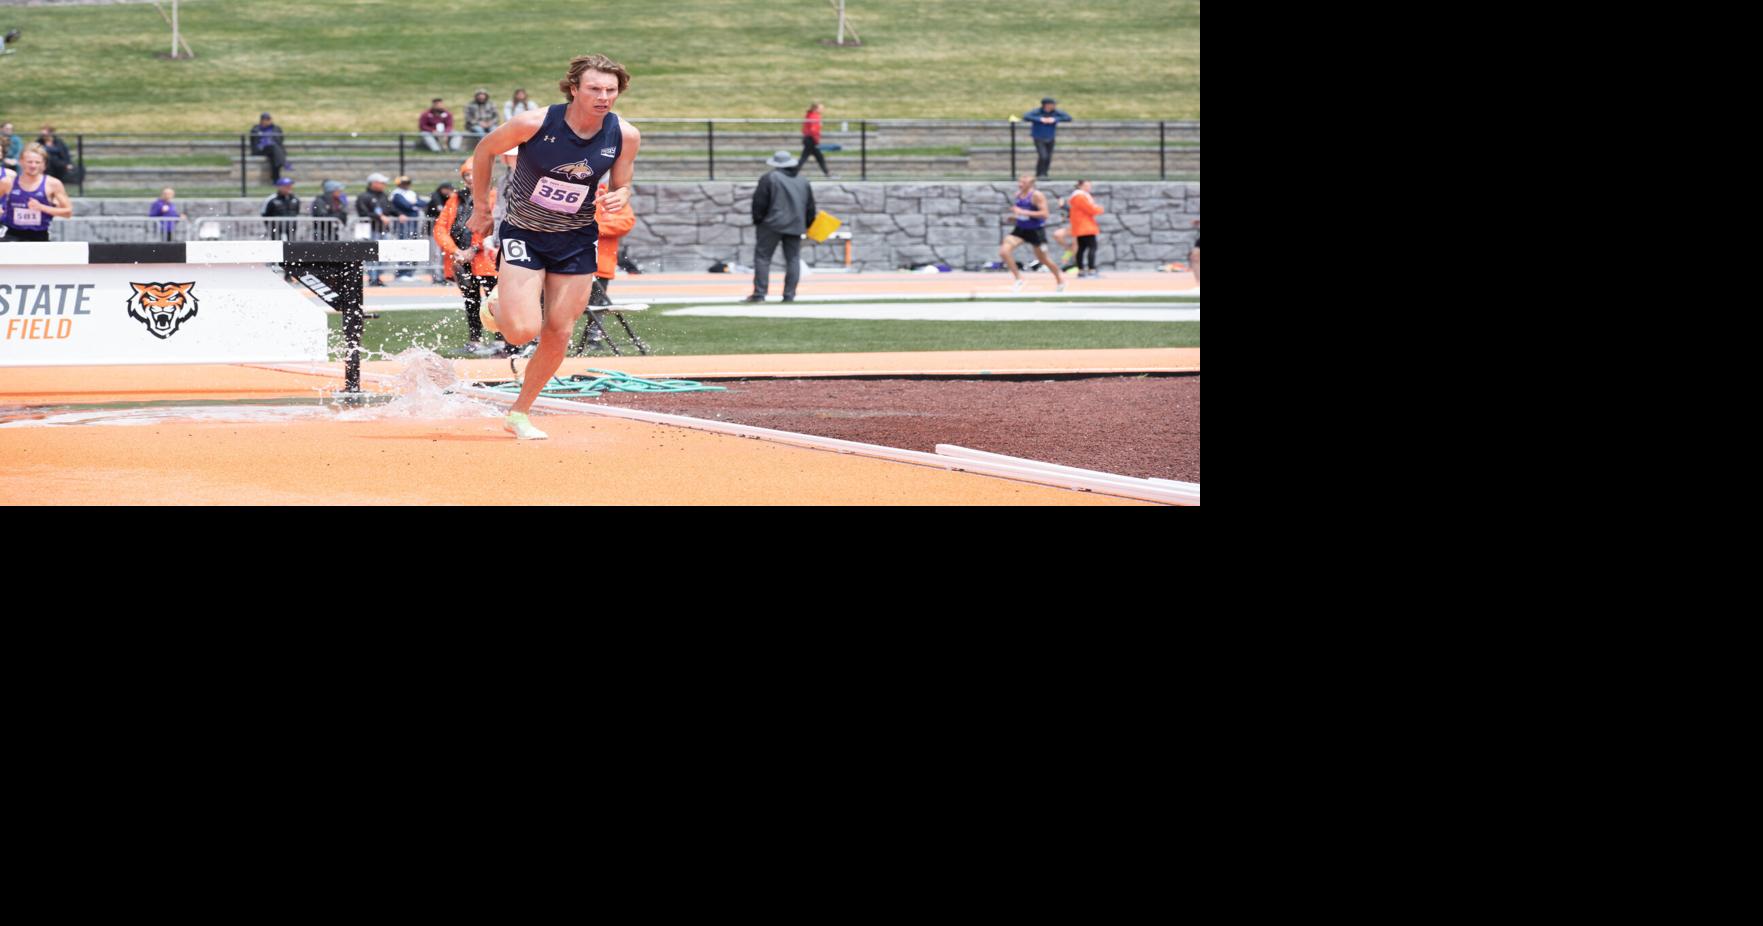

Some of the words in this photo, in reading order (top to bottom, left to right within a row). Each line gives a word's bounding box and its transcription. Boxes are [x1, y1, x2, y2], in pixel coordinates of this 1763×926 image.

[538, 185, 580, 203] 356
[507, 239, 524, 258] 6
[300, 272, 340, 302] GILL
[0, 284, 95, 316] STATE
[6, 318, 72, 340] FIELD
